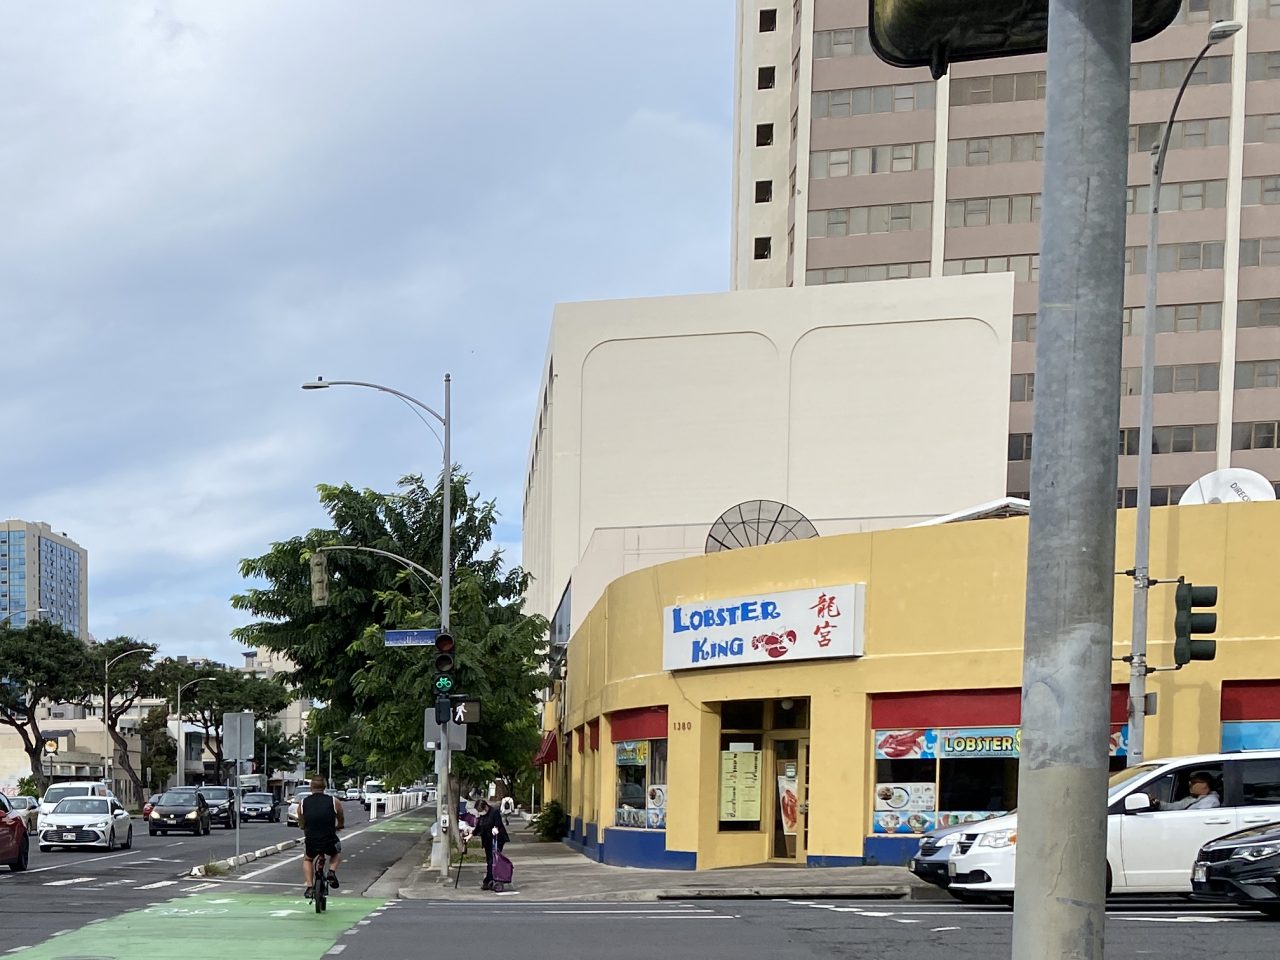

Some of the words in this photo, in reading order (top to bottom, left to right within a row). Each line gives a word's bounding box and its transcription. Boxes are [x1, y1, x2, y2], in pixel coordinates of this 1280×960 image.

[672, 600, 781, 633] LOBSTER
[809, 592, 841, 648] 龍宮
[691, 637, 744, 663] KING
[673, 721, 692, 731] 1380
[944, 735, 1014, 753] LOBSTER
